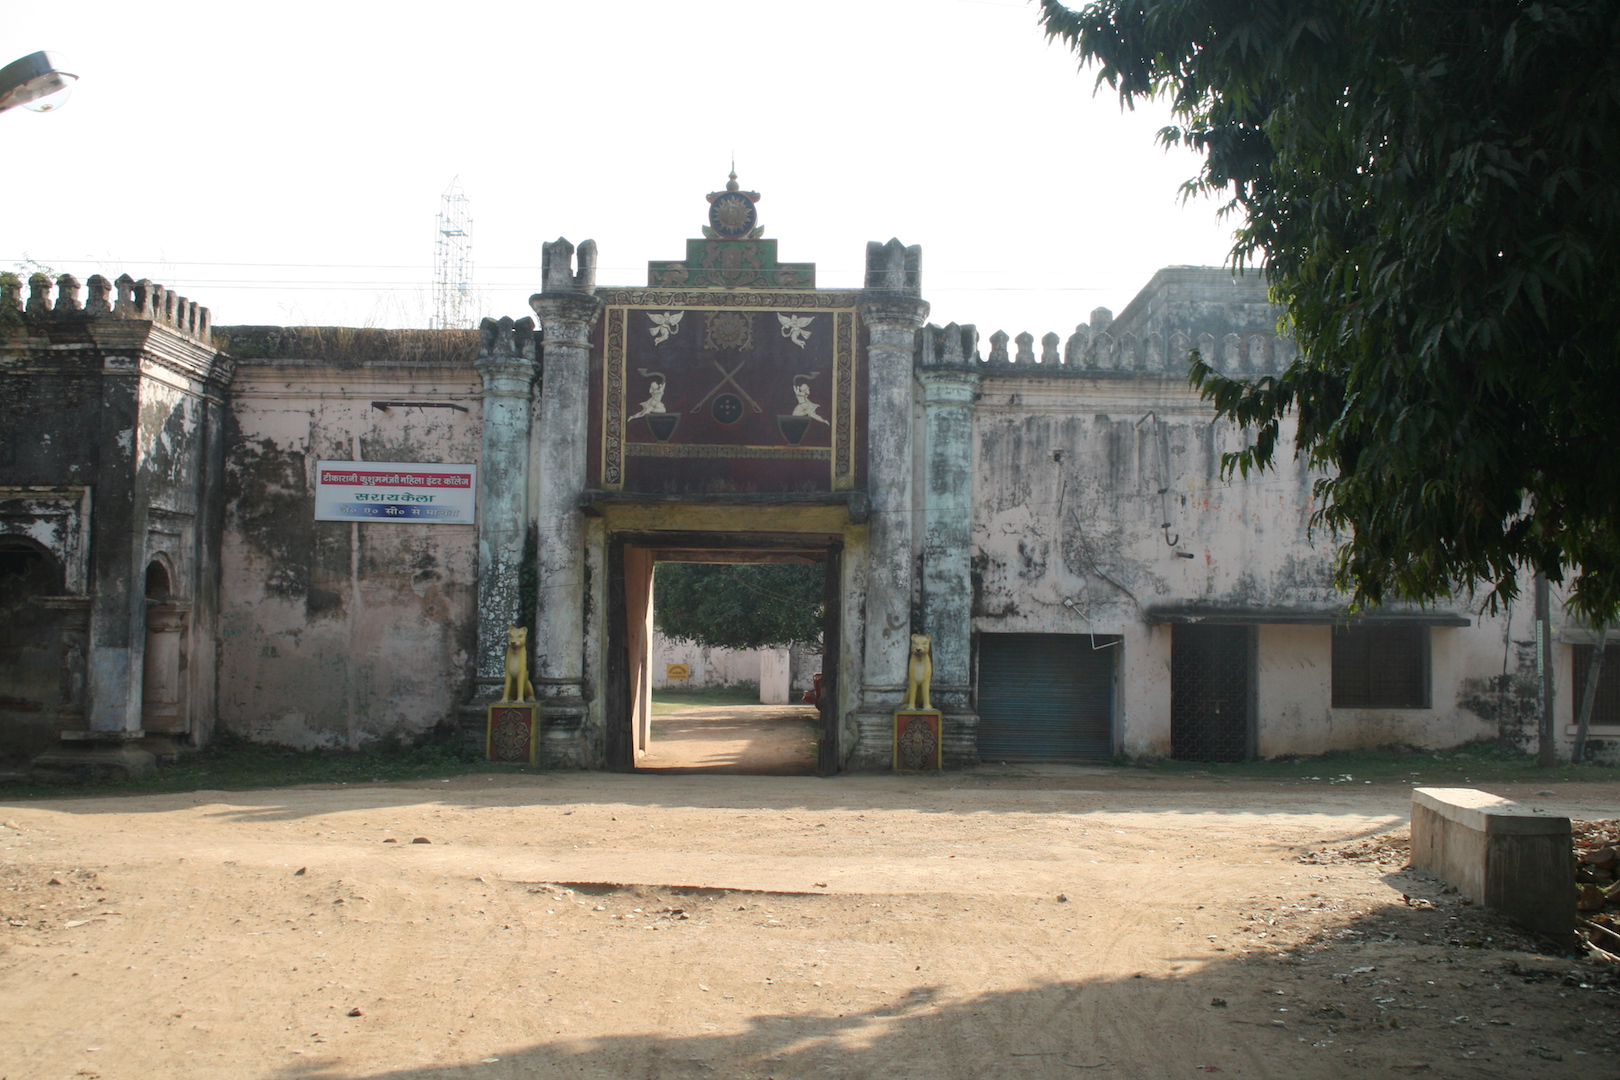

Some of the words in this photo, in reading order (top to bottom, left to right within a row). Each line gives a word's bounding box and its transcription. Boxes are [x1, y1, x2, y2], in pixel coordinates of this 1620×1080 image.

[400, 474, 425, 485] महिला
[426, 475, 442, 486] इंटर
[443, 475, 469, 486] कॉलेज
[354, 492, 436, 503] सरायकेला
[411, 507, 421, 516] से
[426, 508, 461, 517] मान्यता
